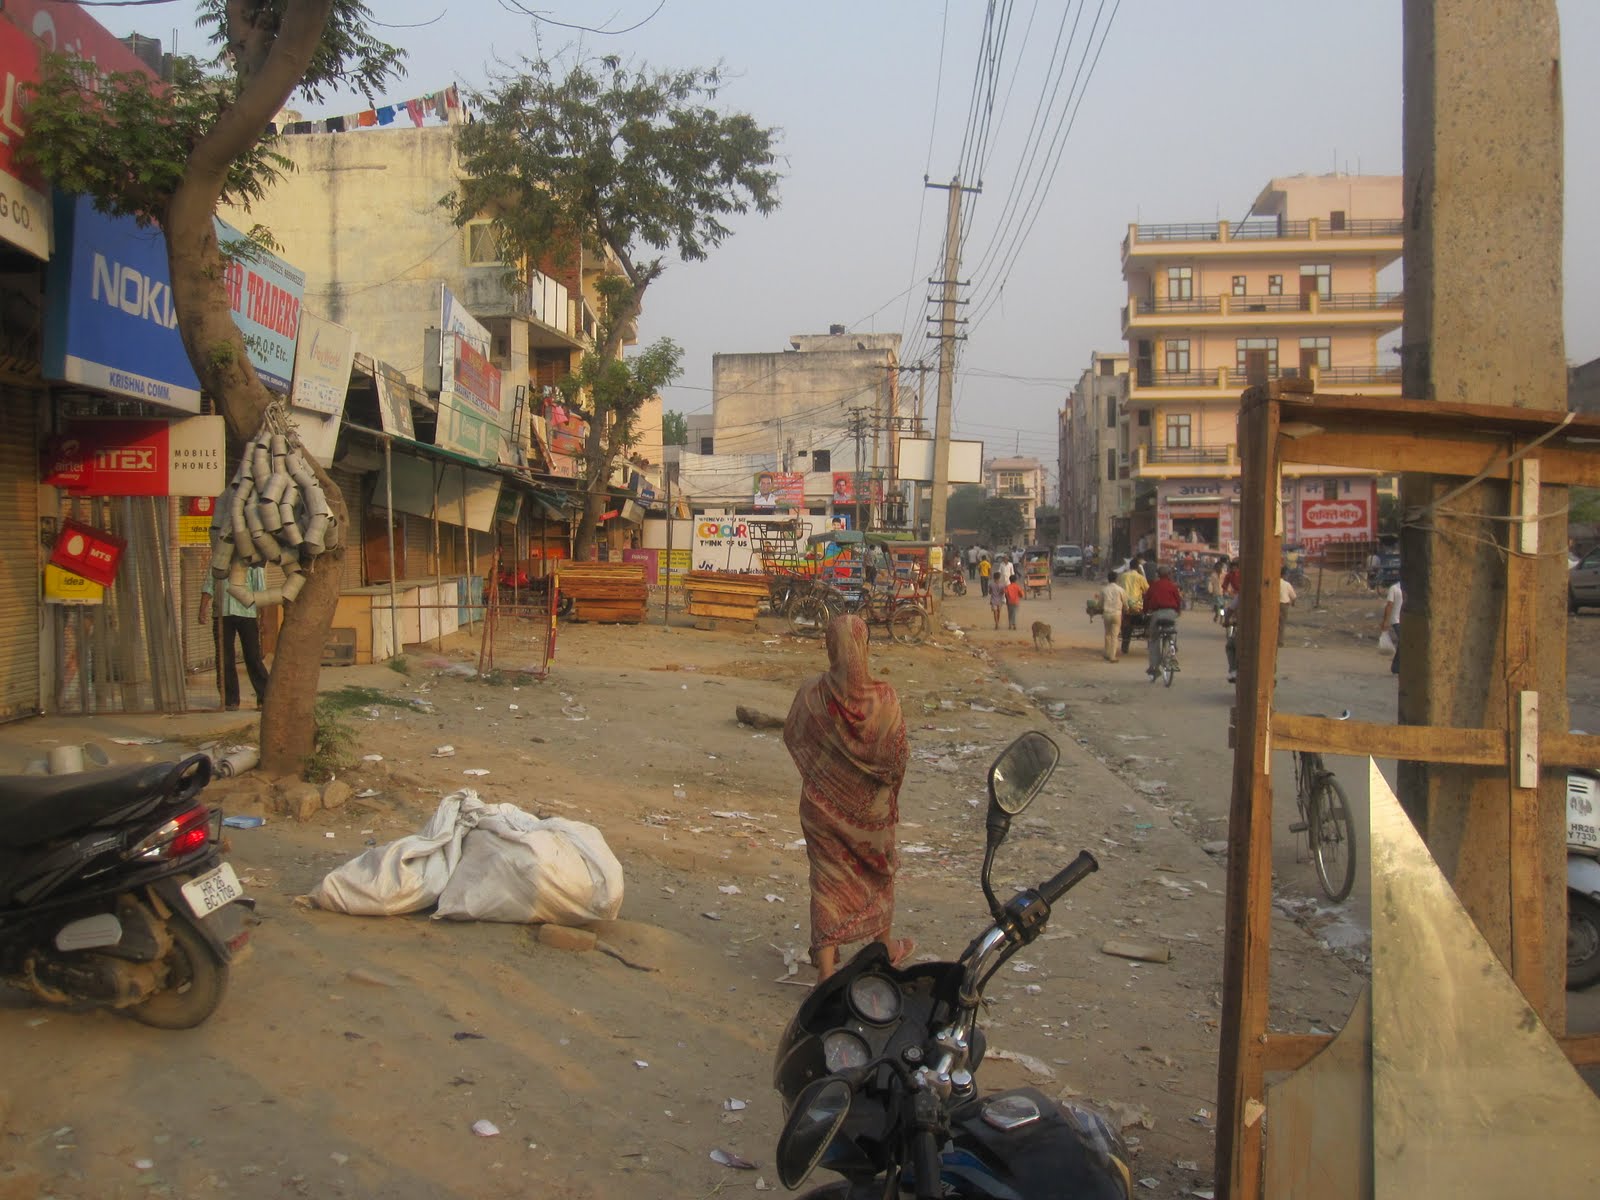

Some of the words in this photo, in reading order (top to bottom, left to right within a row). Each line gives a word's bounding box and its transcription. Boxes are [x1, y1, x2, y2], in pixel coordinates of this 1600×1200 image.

[13, 200, 33, 232] CO.
[247, 272, 299, 340] TRADERS
[109, 372, 145, 395] KRISHNA
[147, 382, 171, 400] COMM.
[174, 449, 217, 457] MOBILE
[55, 462, 84, 472] airtel
[174, 461, 218, 470] PHONES
[698, 522, 748, 538] COLOUR
[89, 548, 112, 563] MTS
[64, 576, 85, 585] idea
[1571, 823, 1595, 834] HR26
[1575, 831, 1597, 842] 7330
[200, 881, 216, 896] HR
